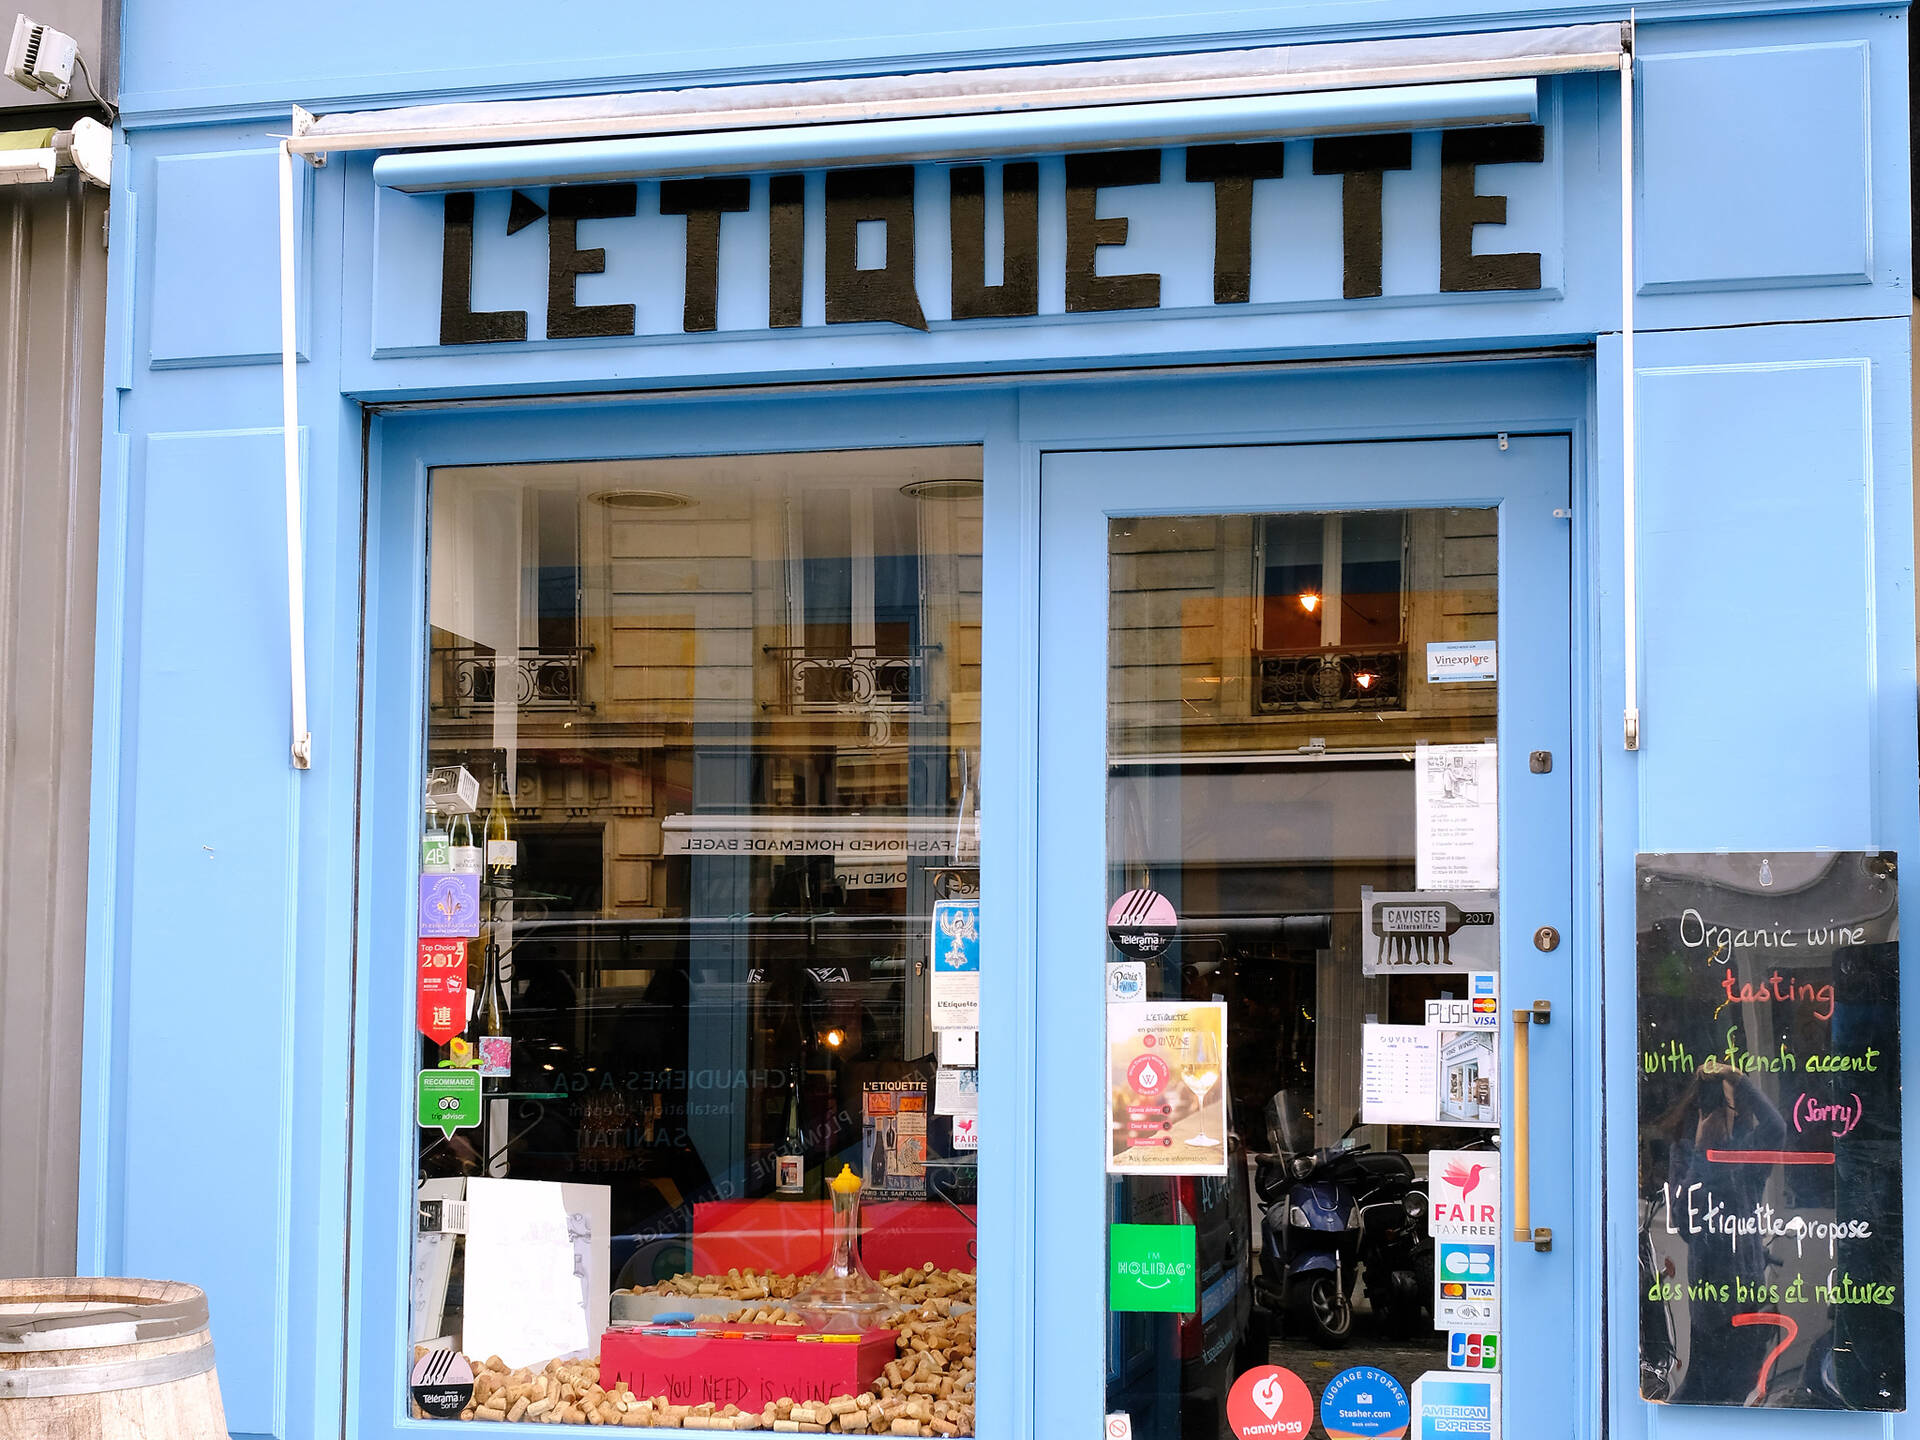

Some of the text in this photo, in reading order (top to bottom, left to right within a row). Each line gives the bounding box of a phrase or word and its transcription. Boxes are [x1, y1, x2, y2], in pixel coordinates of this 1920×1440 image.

[439, 124, 1545, 346] L'ETIQUETTE
[1435, 654, 1489, 666] Vinexplore
[1388, 910, 1441, 923] CAVISTES
[1465, 913, 1492, 923] 2017
[1680, 908, 1867, 964] Organic wine
[1721, 968, 1835, 1020] tasting
[1428, 1003, 1470, 1024] PUSH
[1474, 1016, 1497, 1025] VISA
[1643, 1025, 1880, 1074] with a french accent
[863, 1081, 928, 1091] L'ETIQUETTE
[1435, 1203, 1495, 1222] FAIR
[1472, 1288, 1492, 1297] VISA
[1648, 1271, 1682, 1302] des
[1687, 1278, 1729, 1302] vins
[1736, 1275, 1780, 1303] bios
[1785, 1273, 1809, 1303] et
[1451, 1343, 1496, 1358] JCB
[664, 1374, 692, 1402] YOU
[703, 1374, 748, 1402] NEED
[1324, 1371, 1406, 1407] LUGGAGE STORAGE
[1339, 1409, 1391, 1419] Stasher.com
[1422, 1406, 1487, 1418] AMERICAN
[1243, 1421, 1302, 1436] nannybag
[1436, 1420, 1491, 1432] EXPRESS
